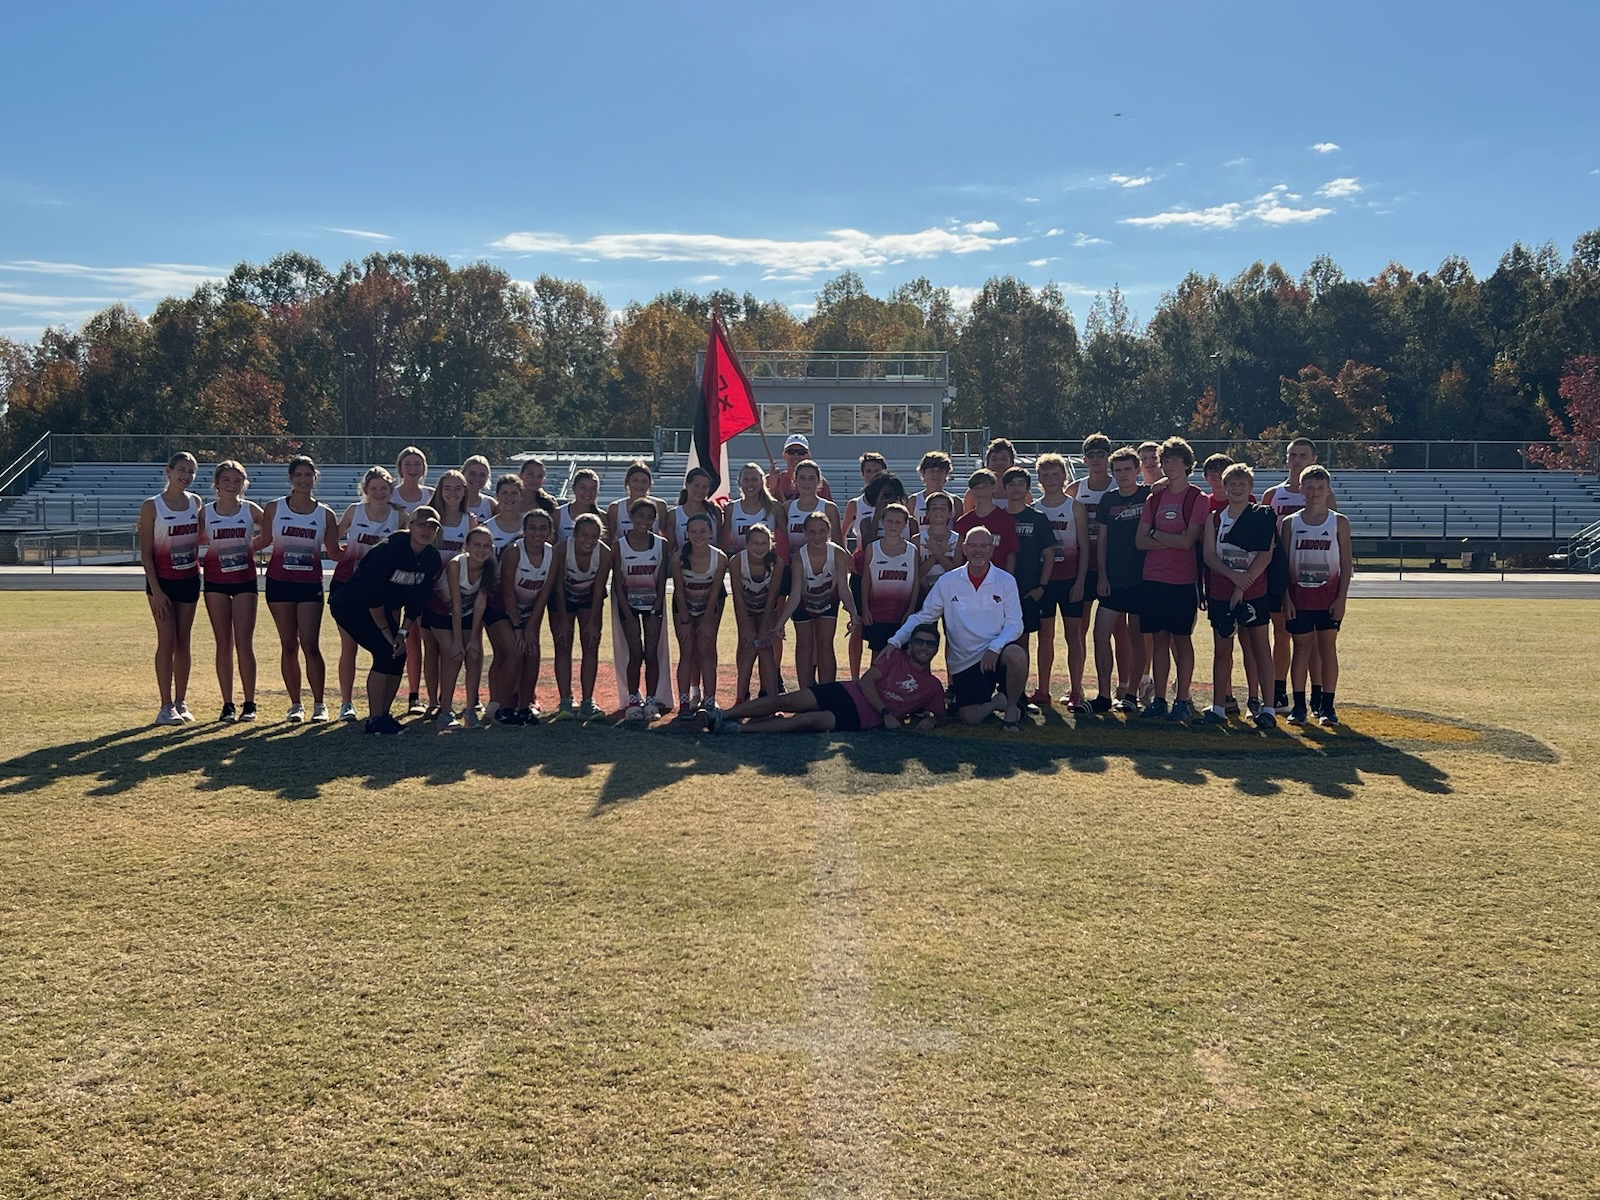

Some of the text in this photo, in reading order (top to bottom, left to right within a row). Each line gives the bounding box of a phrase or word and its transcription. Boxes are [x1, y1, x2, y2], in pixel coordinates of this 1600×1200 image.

[213, 527, 247, 540] LANDRUM
[282, 525, 317, 540] LANDRUM
[1295, 539, 1332, 551] LANDRUM
